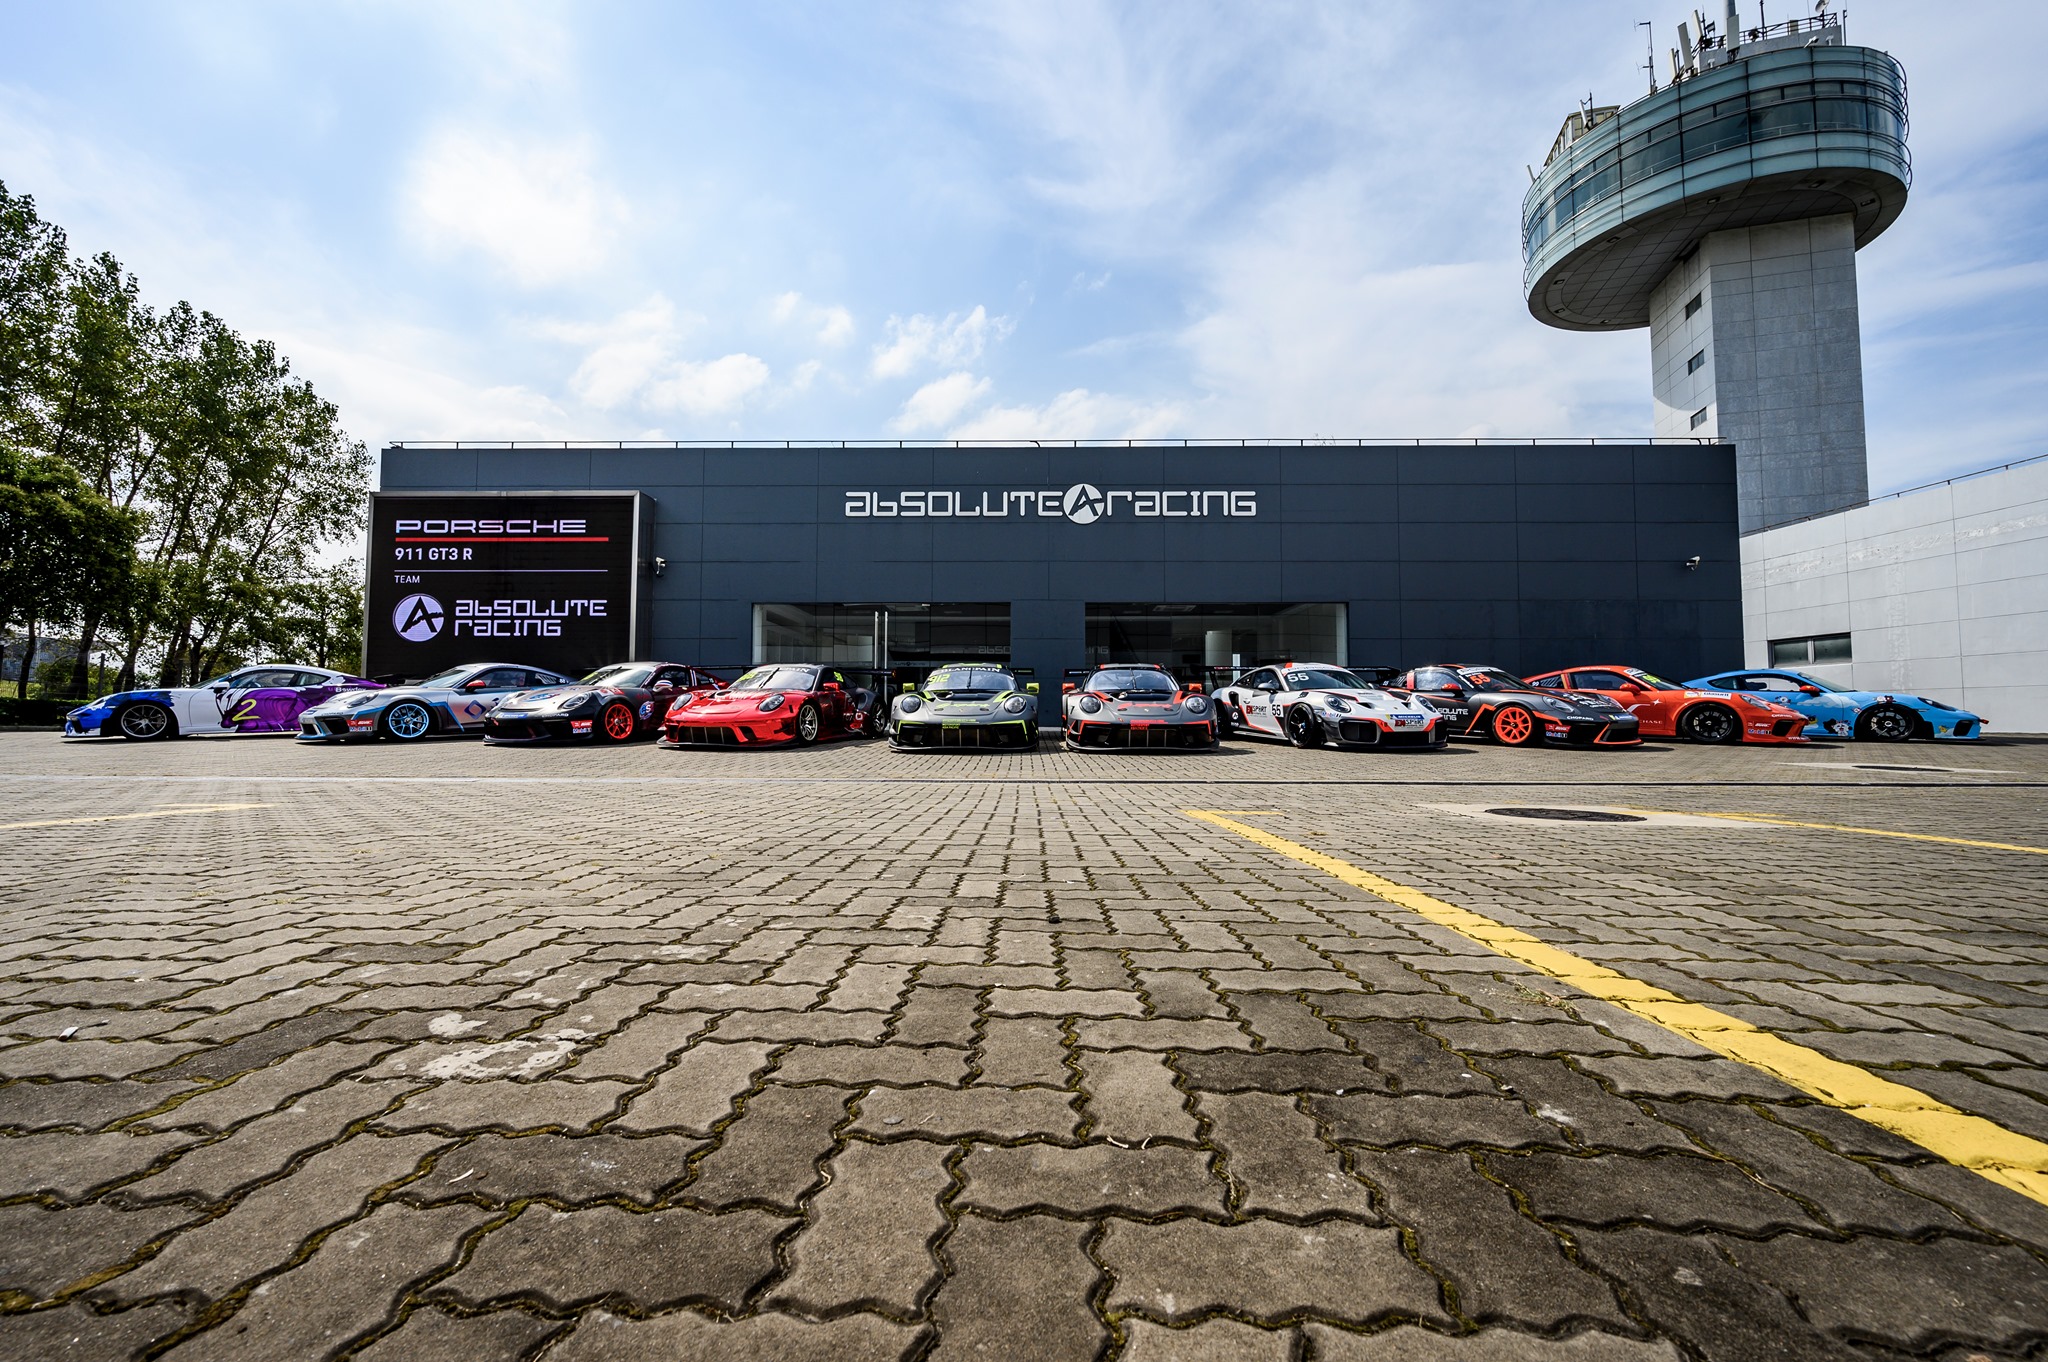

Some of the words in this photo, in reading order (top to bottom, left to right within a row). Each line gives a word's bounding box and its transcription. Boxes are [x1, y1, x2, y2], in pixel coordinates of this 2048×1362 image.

[395, 519, 586, 534] PORSCHE
[395, 547, 423, 561] 911
[428, 547, 459, 561] GT3
[463, 548, 473, 561] R
[394, 575, 420, 584] TEAM
[928, 674, 951, 684] 912
[1287, 672, 1309, 683] 55
[1470, 673, 1490, 685] 55
[232, 698, 261, 721] 2
[1271, 704, 1281, 716] 55
